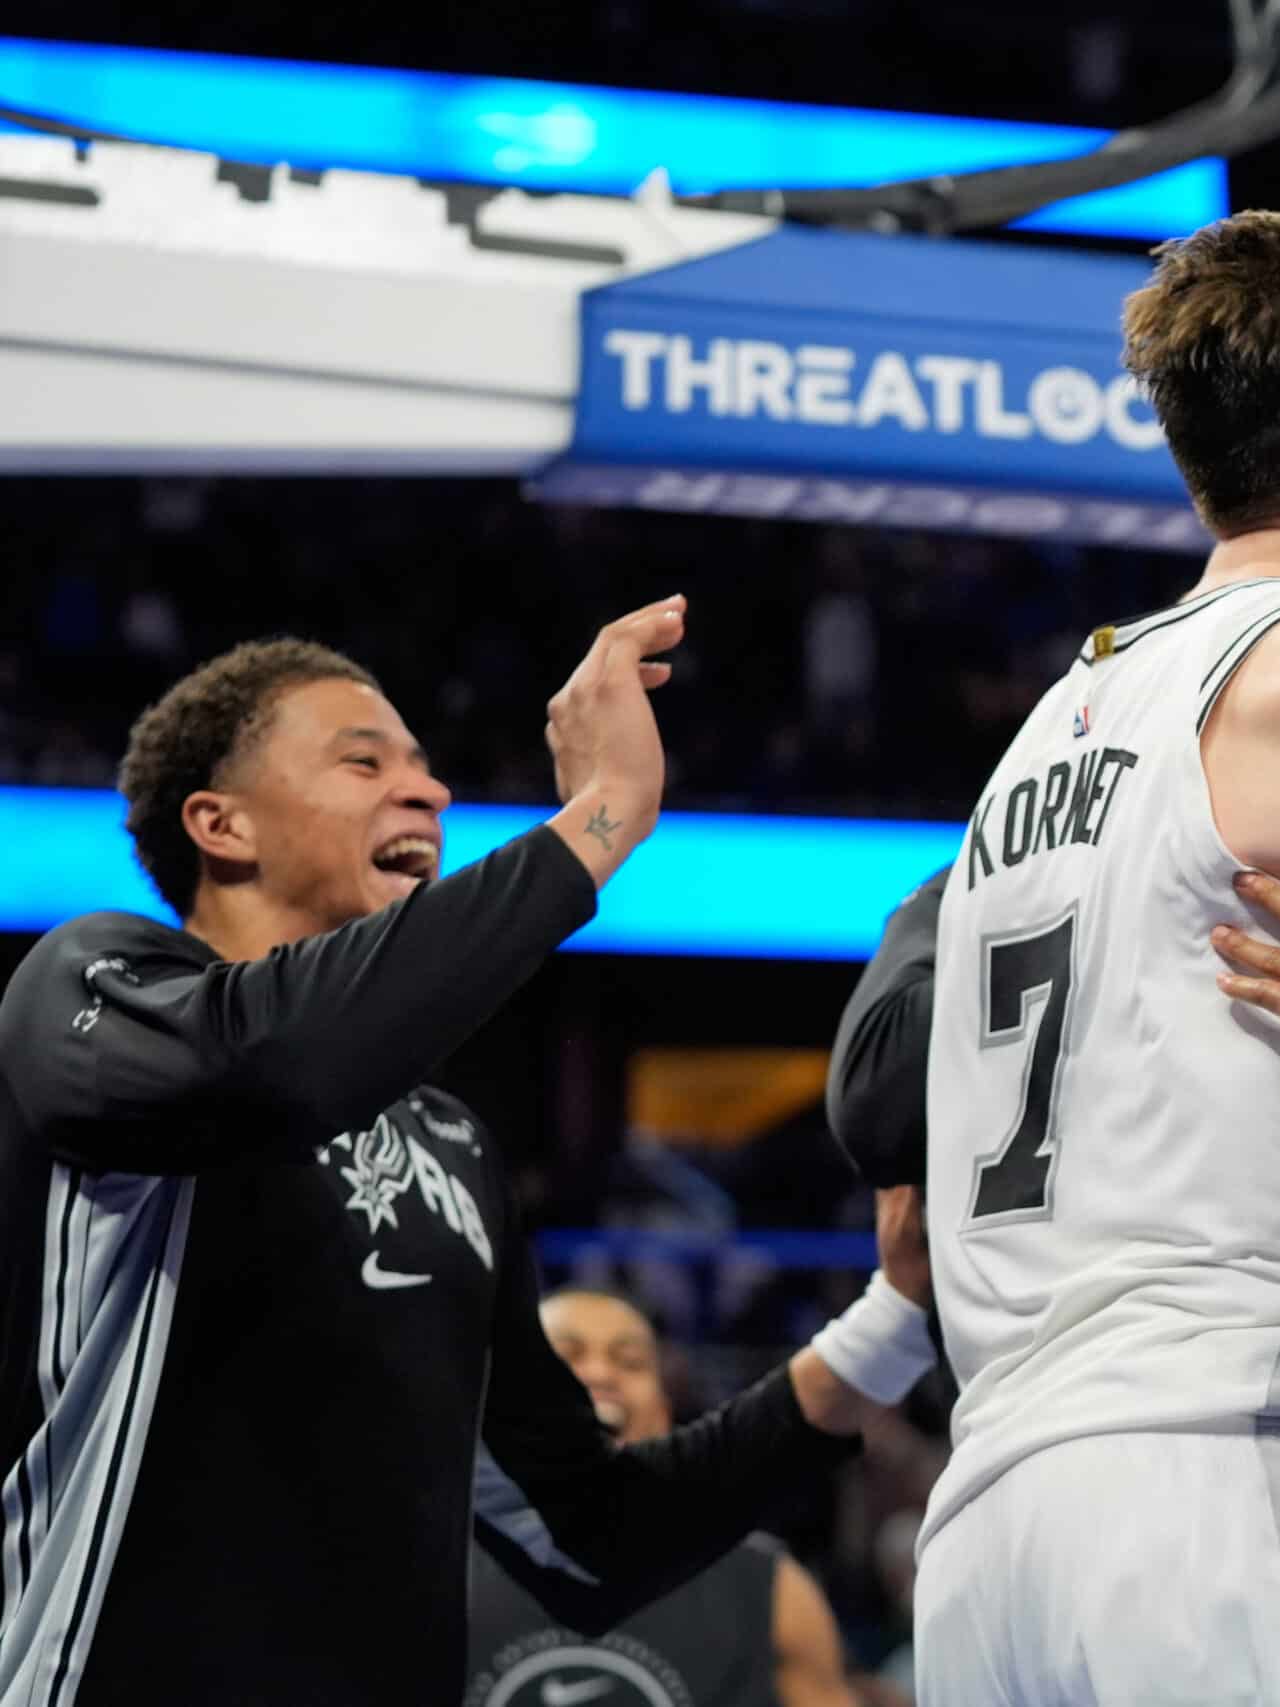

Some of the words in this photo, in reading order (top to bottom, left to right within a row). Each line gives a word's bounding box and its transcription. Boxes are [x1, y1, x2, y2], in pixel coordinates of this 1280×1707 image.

[605, 330, 1166, 450] THREATLOC
[968, 747, 1139, 892] KORNET
[959, 898, 1080, 1235] 7
